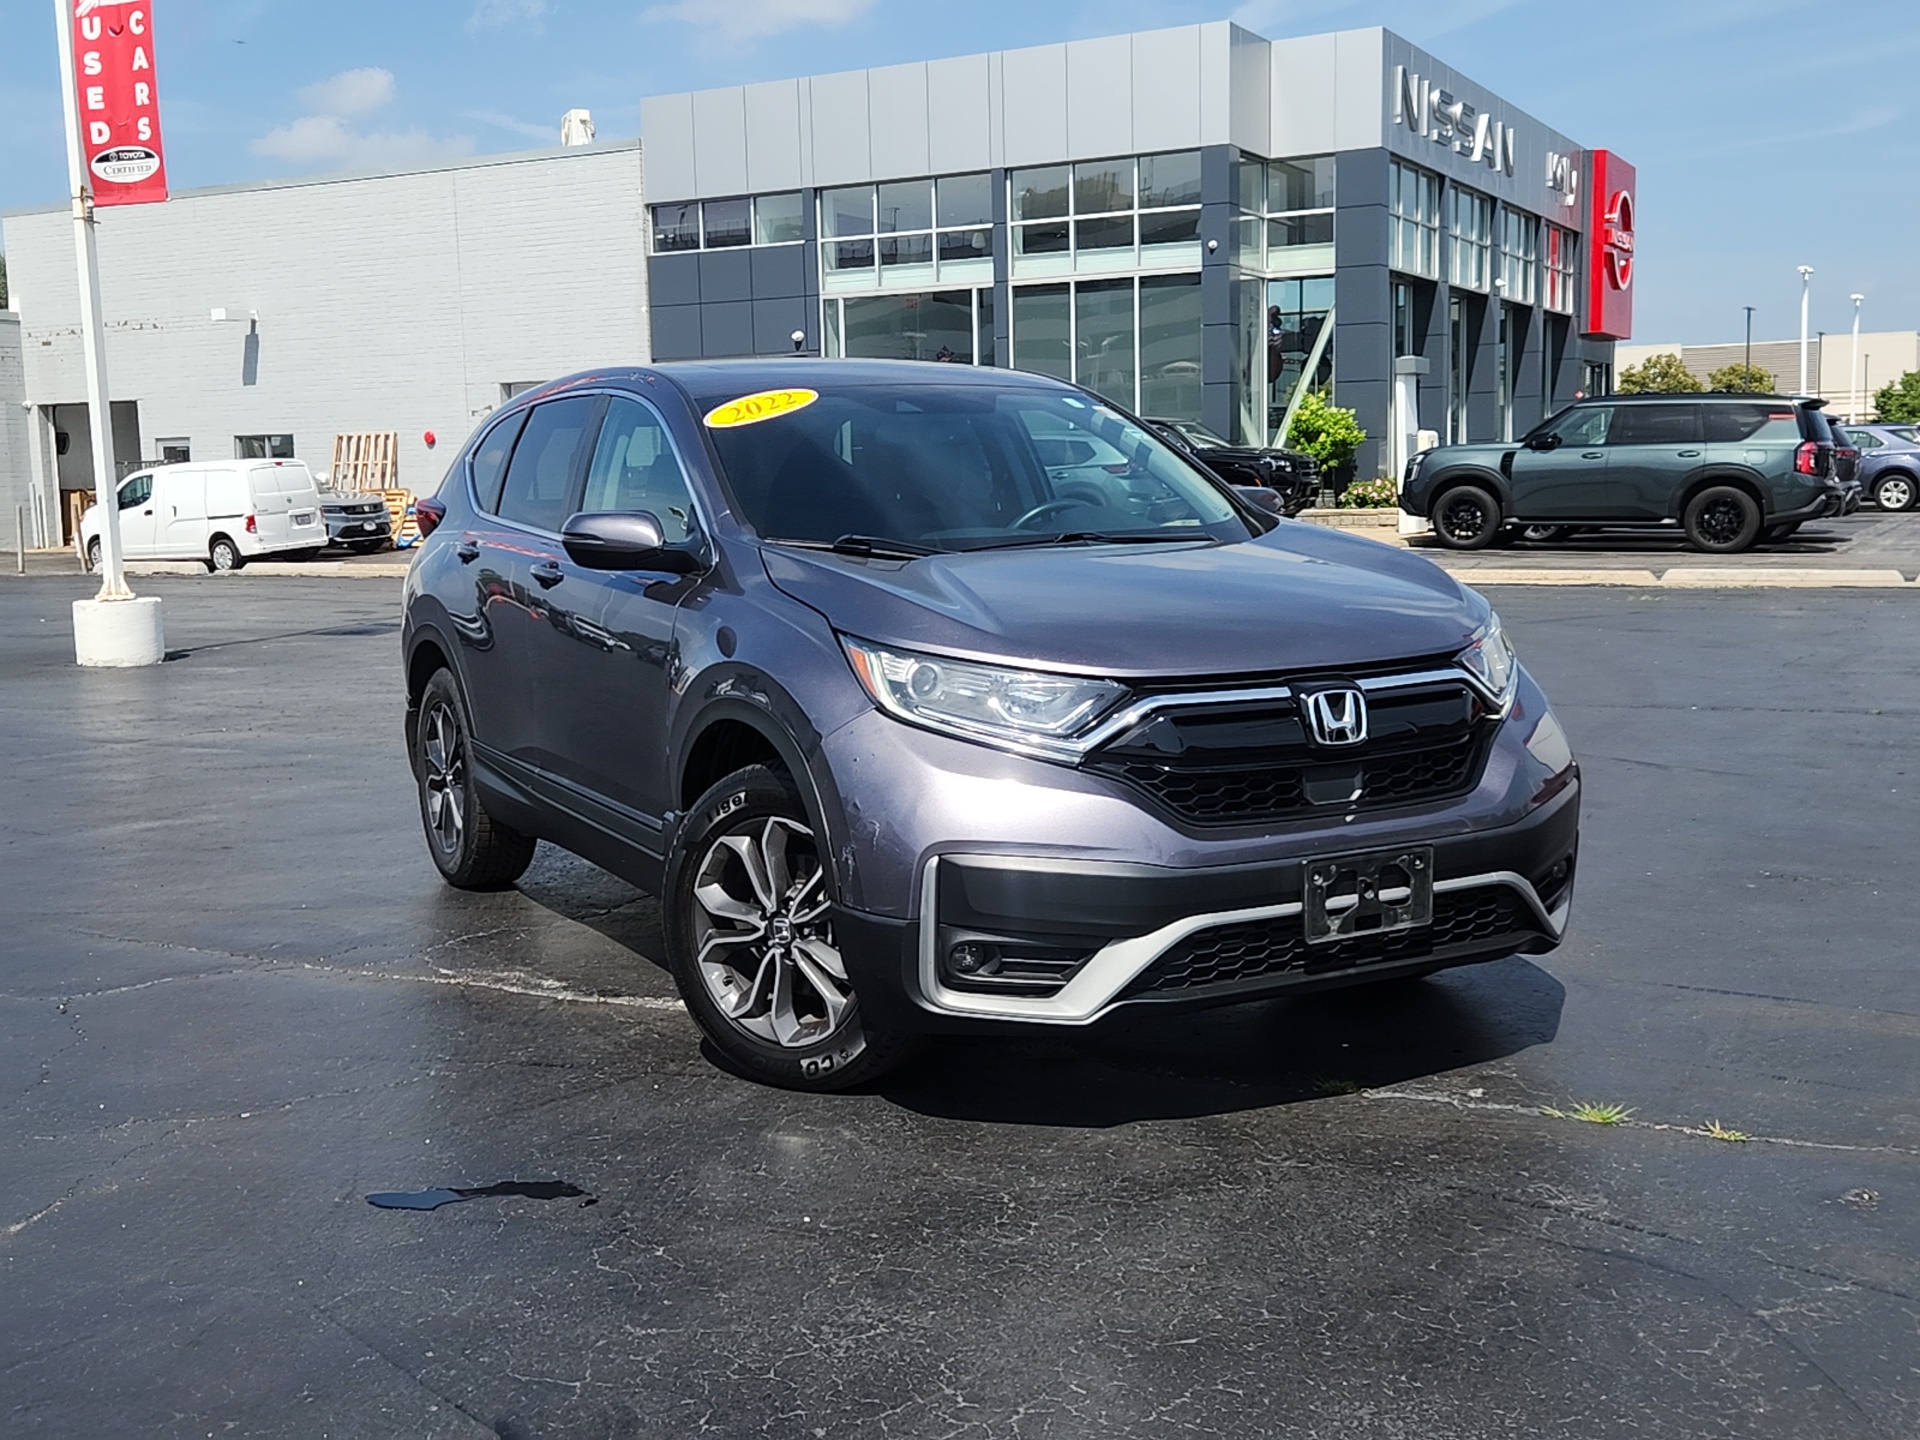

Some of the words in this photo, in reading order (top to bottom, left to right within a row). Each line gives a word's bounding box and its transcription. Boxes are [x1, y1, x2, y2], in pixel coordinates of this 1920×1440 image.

[81, 16, 111, 145] USED
[129, 10, 152, 141] CARS
[1393, 65, 1515, 177] NISSAN
[118, 151, 147, 160] TOYOTA
[728, 392, 797, 422] 2022
